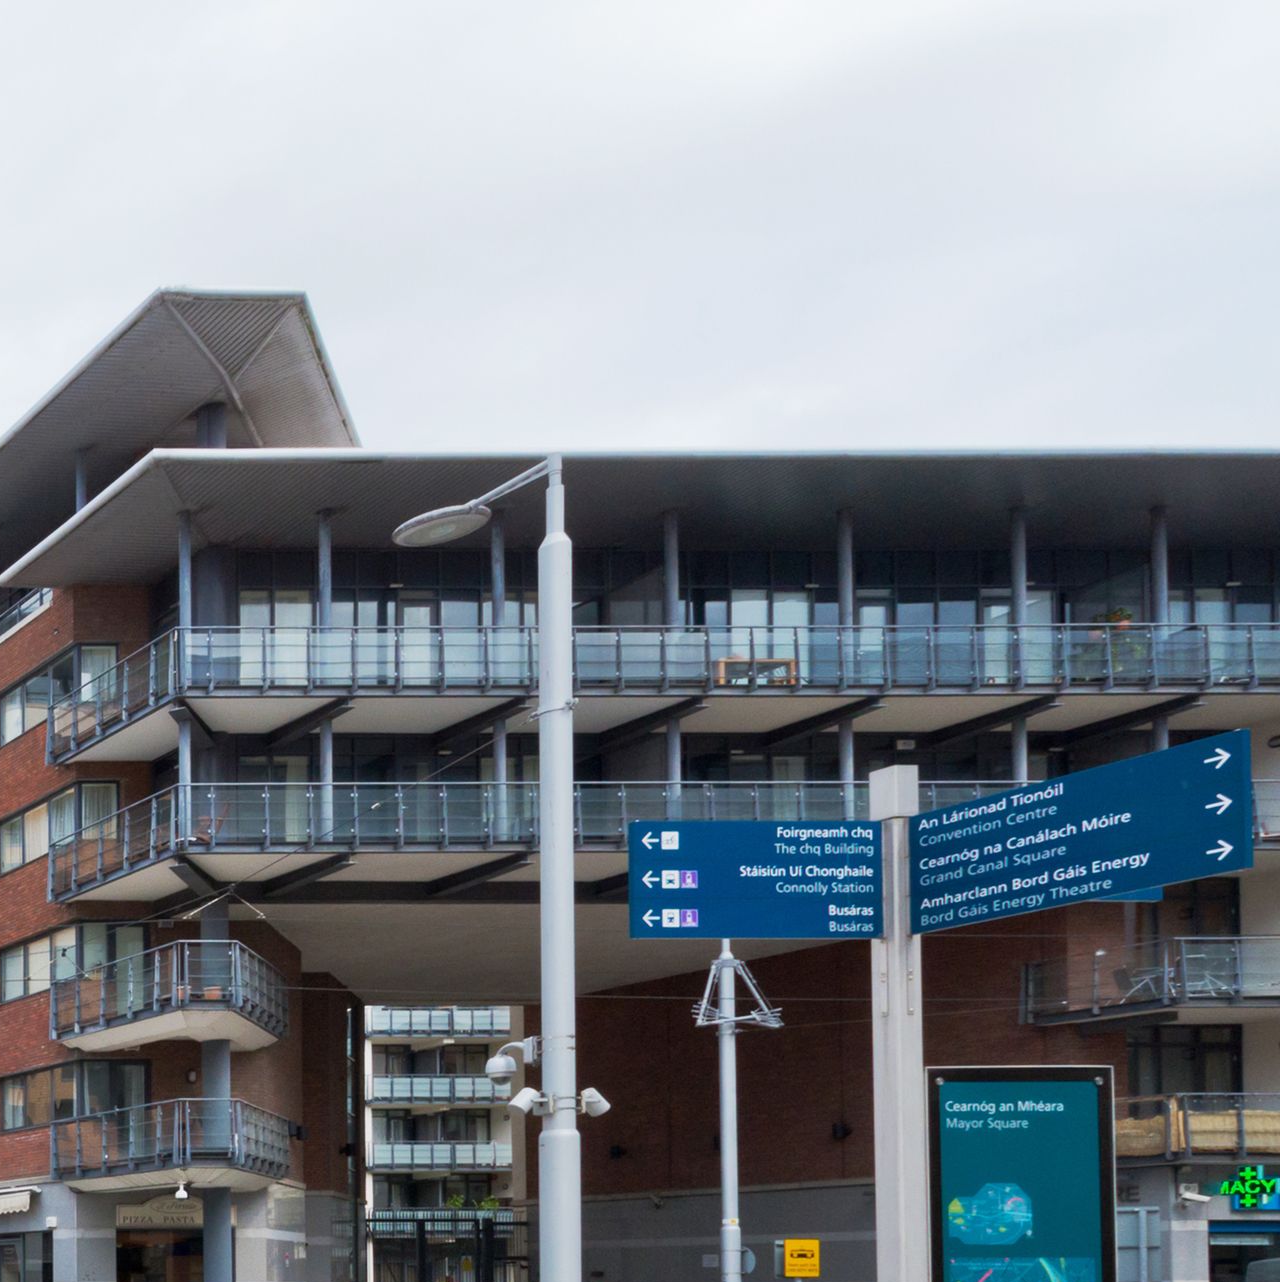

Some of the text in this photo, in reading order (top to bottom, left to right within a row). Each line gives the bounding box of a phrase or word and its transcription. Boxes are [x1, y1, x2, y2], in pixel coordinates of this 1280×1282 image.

[918, 783, 1064, 831] An Lárionad Tionóil
[919, 804, 1057, 847] Convention Centre
[776, 827, 873, 840] Foirgneamh chq
[919, 811, 1131, 870] Cearnóg na Canálach Móire
[774, 843, 874, 857] The chq Building
[739, 865, 785, 877] Stáisiún
[805, 865, 874, 879] Chonghaile
[919, 845, 1067, 886] Grand Canal Square
[920, 852, 1150, 909] Amharclann Bord Gáis Energy
[776, 882, 874, 895] Connolly Station
[920, 878, 1112, 927] Bord Gáis Energy Theatre
[828, 904, 874, 916] Busáras
[829, 921, 874, 932] Busáras
[945, 1100, 1064, 1115] Cearnóg an Mhéara
[946, 1117, 1029, 1131] Mayor Square
[122, 1216, 195, 1224] PIZZA PASTA
